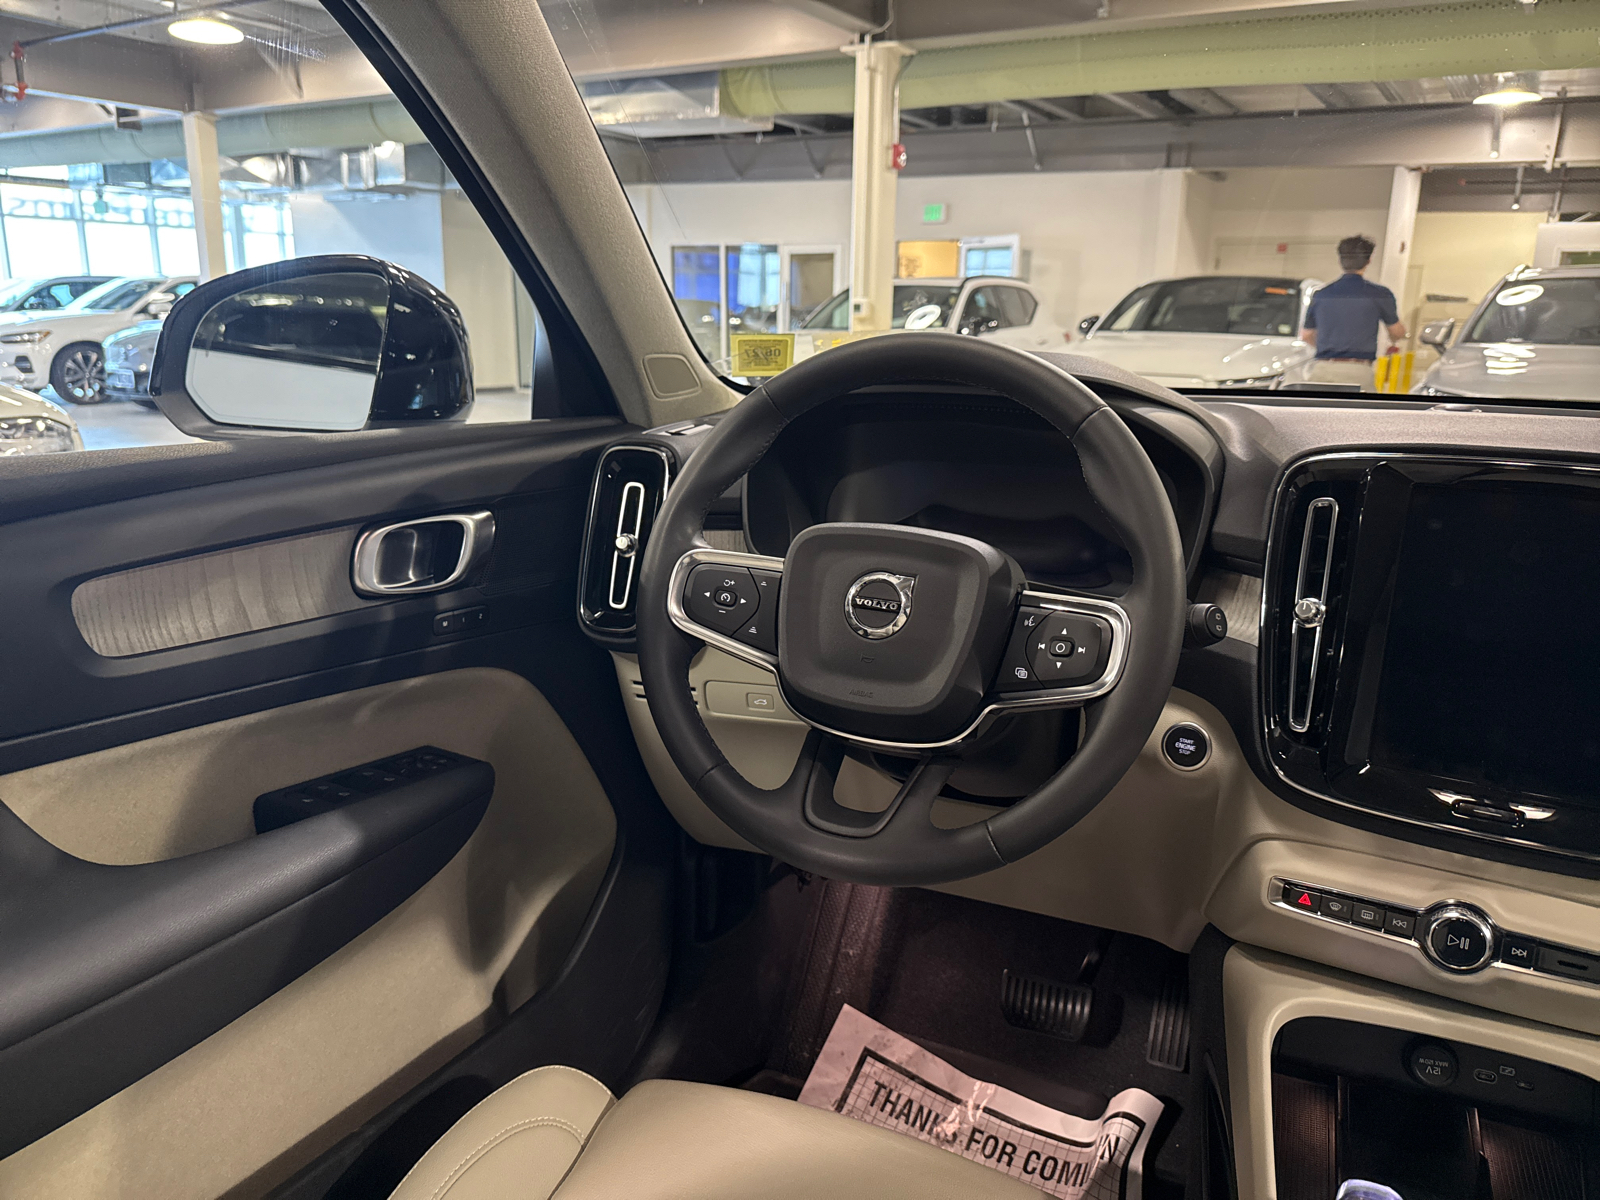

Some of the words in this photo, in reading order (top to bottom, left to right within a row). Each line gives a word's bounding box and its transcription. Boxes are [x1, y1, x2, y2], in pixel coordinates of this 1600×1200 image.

[855, 597, 900, 610] VOLVO
[1175, 741, 1196, 751] ENGINE
[1425, 1065, 1441, 1075] 12V
[964, 1126, 1018, 1168] FOR
[1022, 1149, 1092, 1188] COMI
